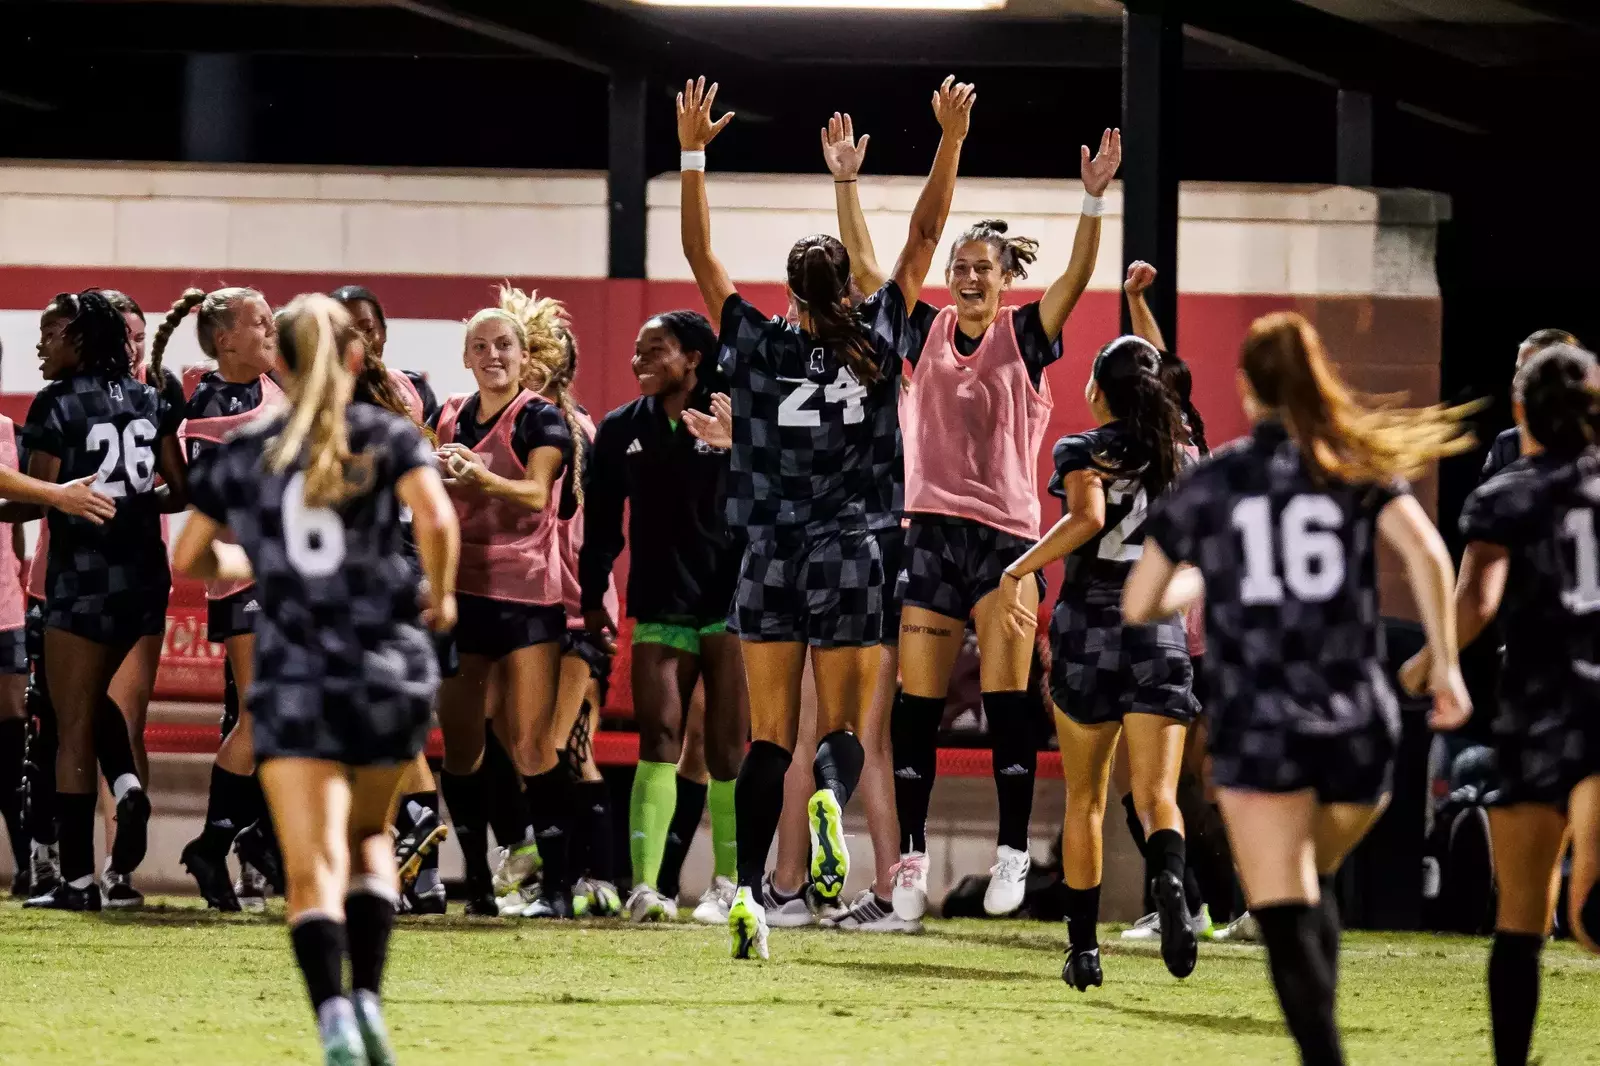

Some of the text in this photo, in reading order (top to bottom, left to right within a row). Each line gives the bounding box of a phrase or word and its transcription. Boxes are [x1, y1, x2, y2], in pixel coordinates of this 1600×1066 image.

[776, 364, 868, 427] 24
[86, 418, 157, 498] 26
[281, 469, 347, 578] 6
[1231, 494, 1346, 606] 16
